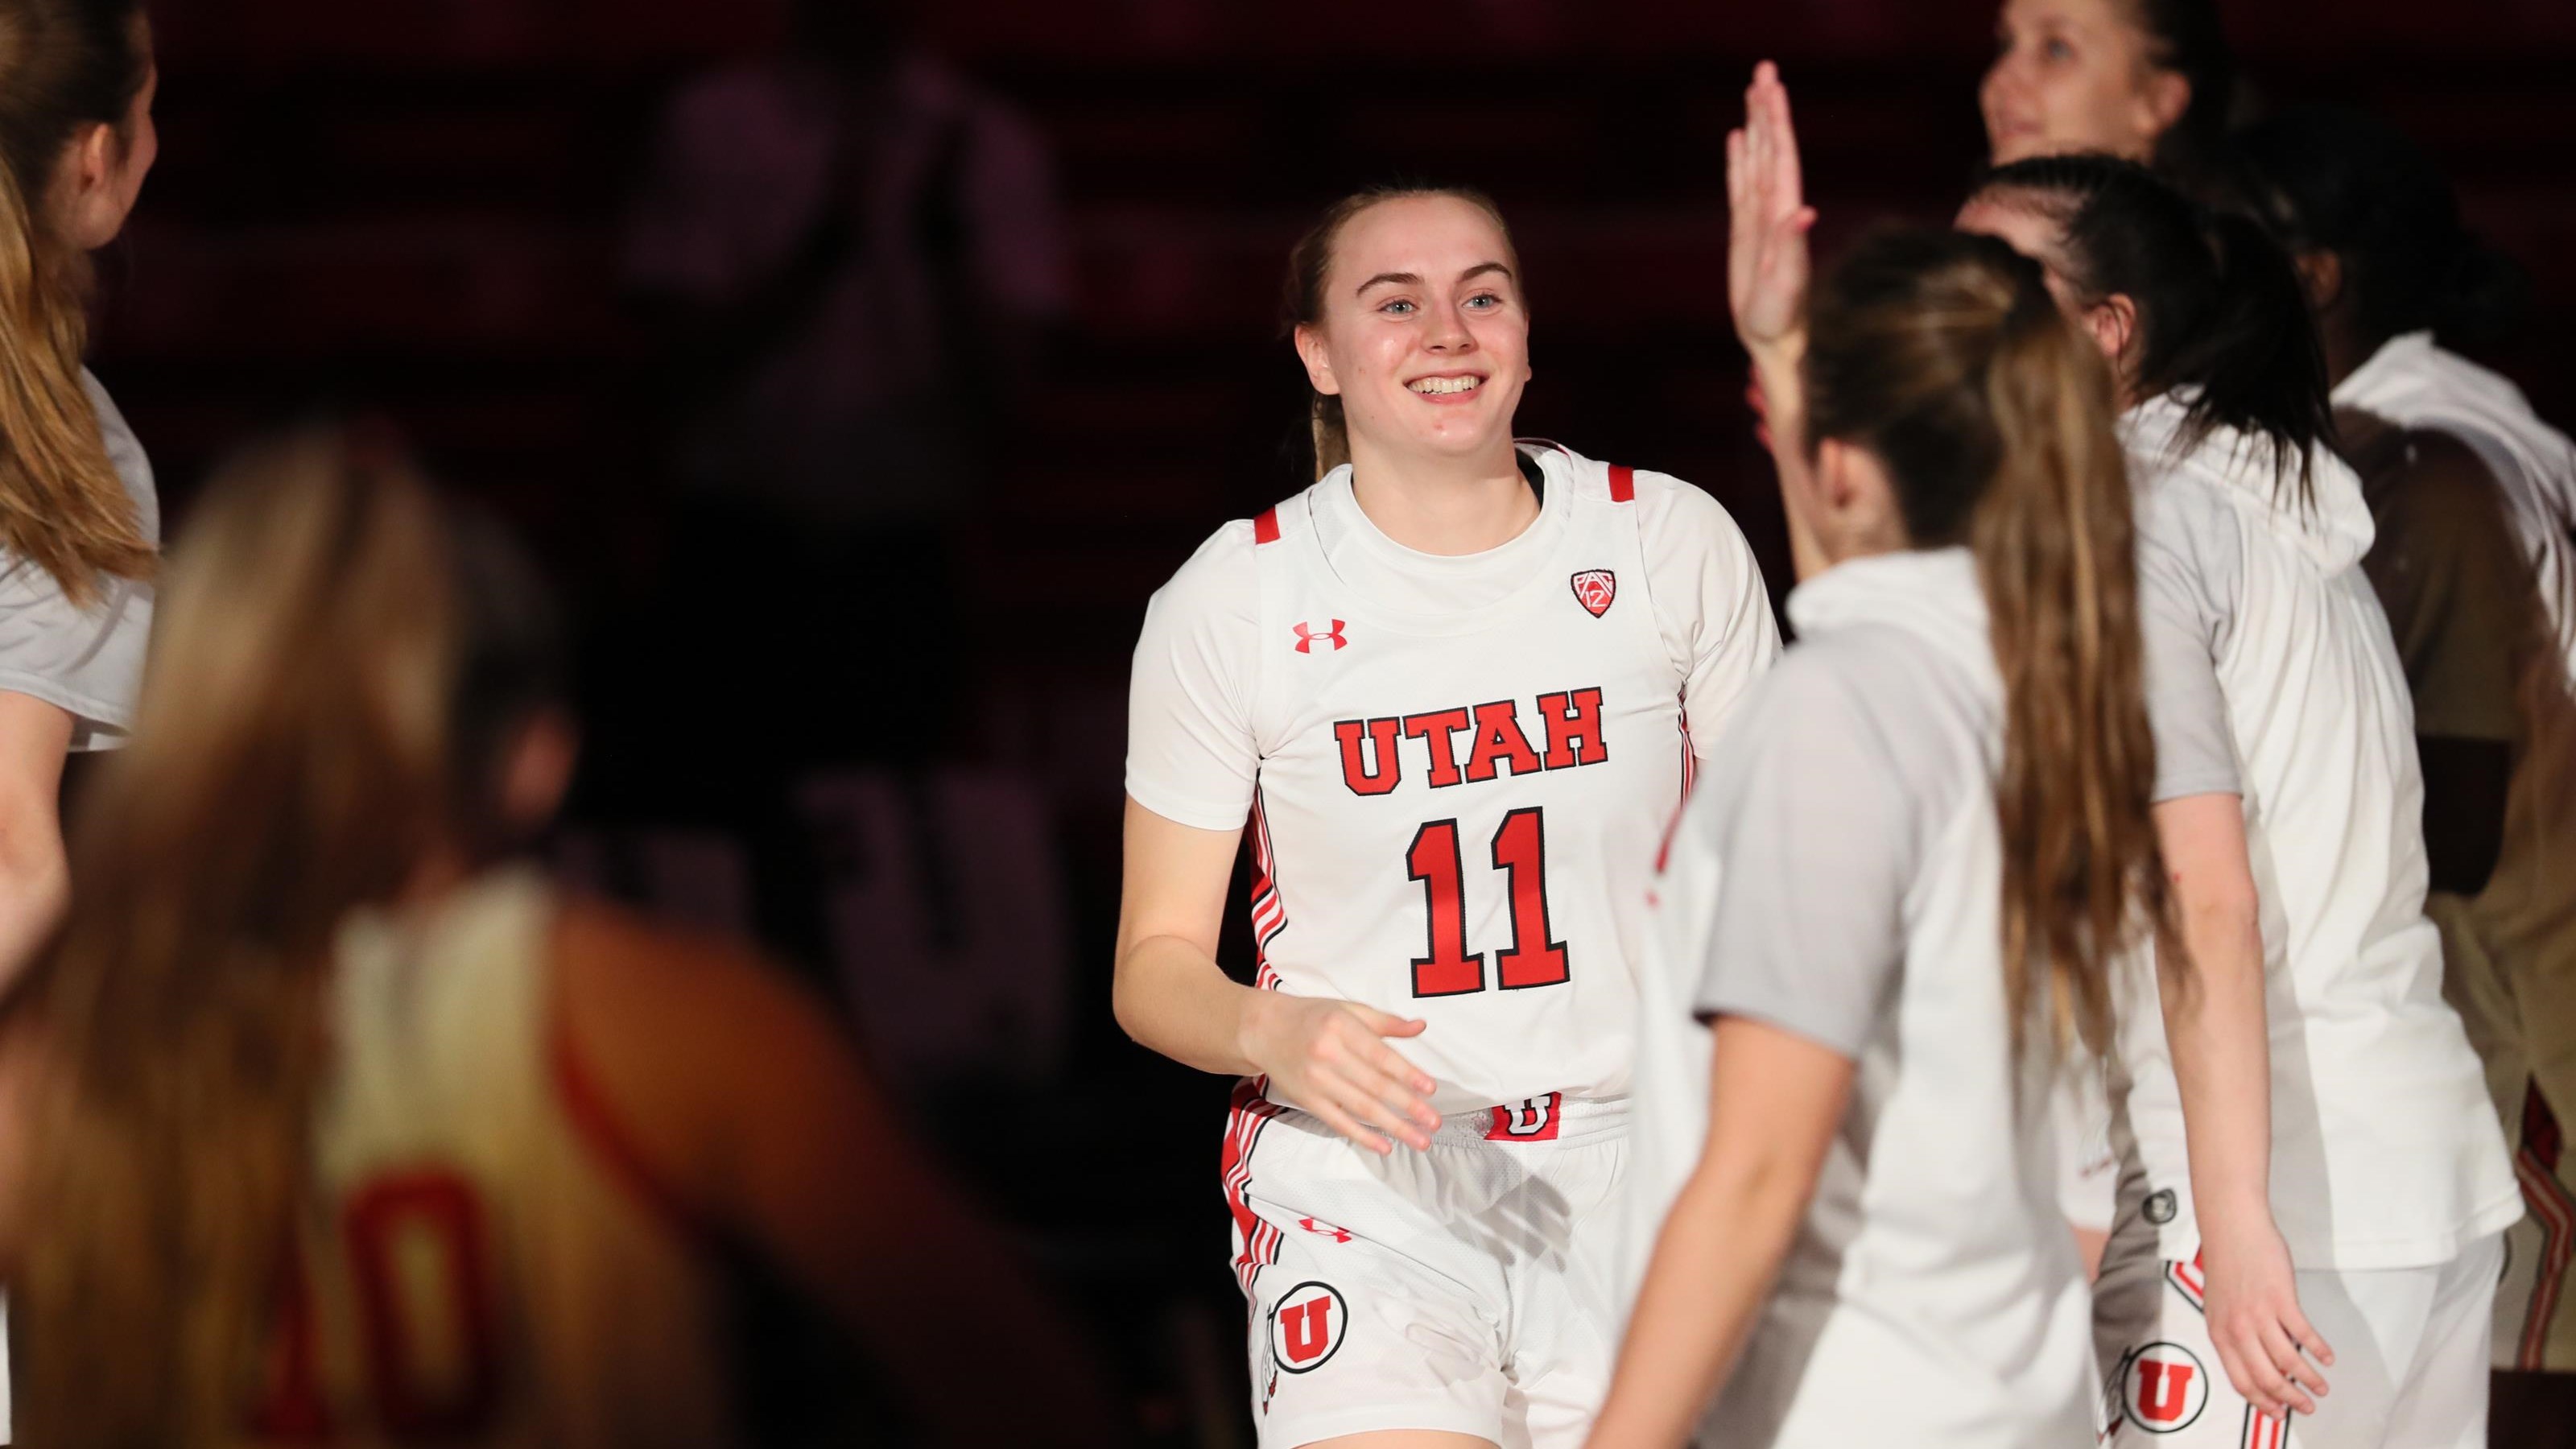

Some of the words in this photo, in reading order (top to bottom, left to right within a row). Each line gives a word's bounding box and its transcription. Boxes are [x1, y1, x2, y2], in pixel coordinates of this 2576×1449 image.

[1573, 571, 1614, 600] PAC
[1585, 589, 1607, 608] 12
[1333, 687, 1608, 796] UTAH
[1406, 806, 1571, 998] 11
[1502, 1094, 1552, 1136] U
[1280, 1295, 1331, 1364] U
[2138, 1358, 2194, 1422] U
